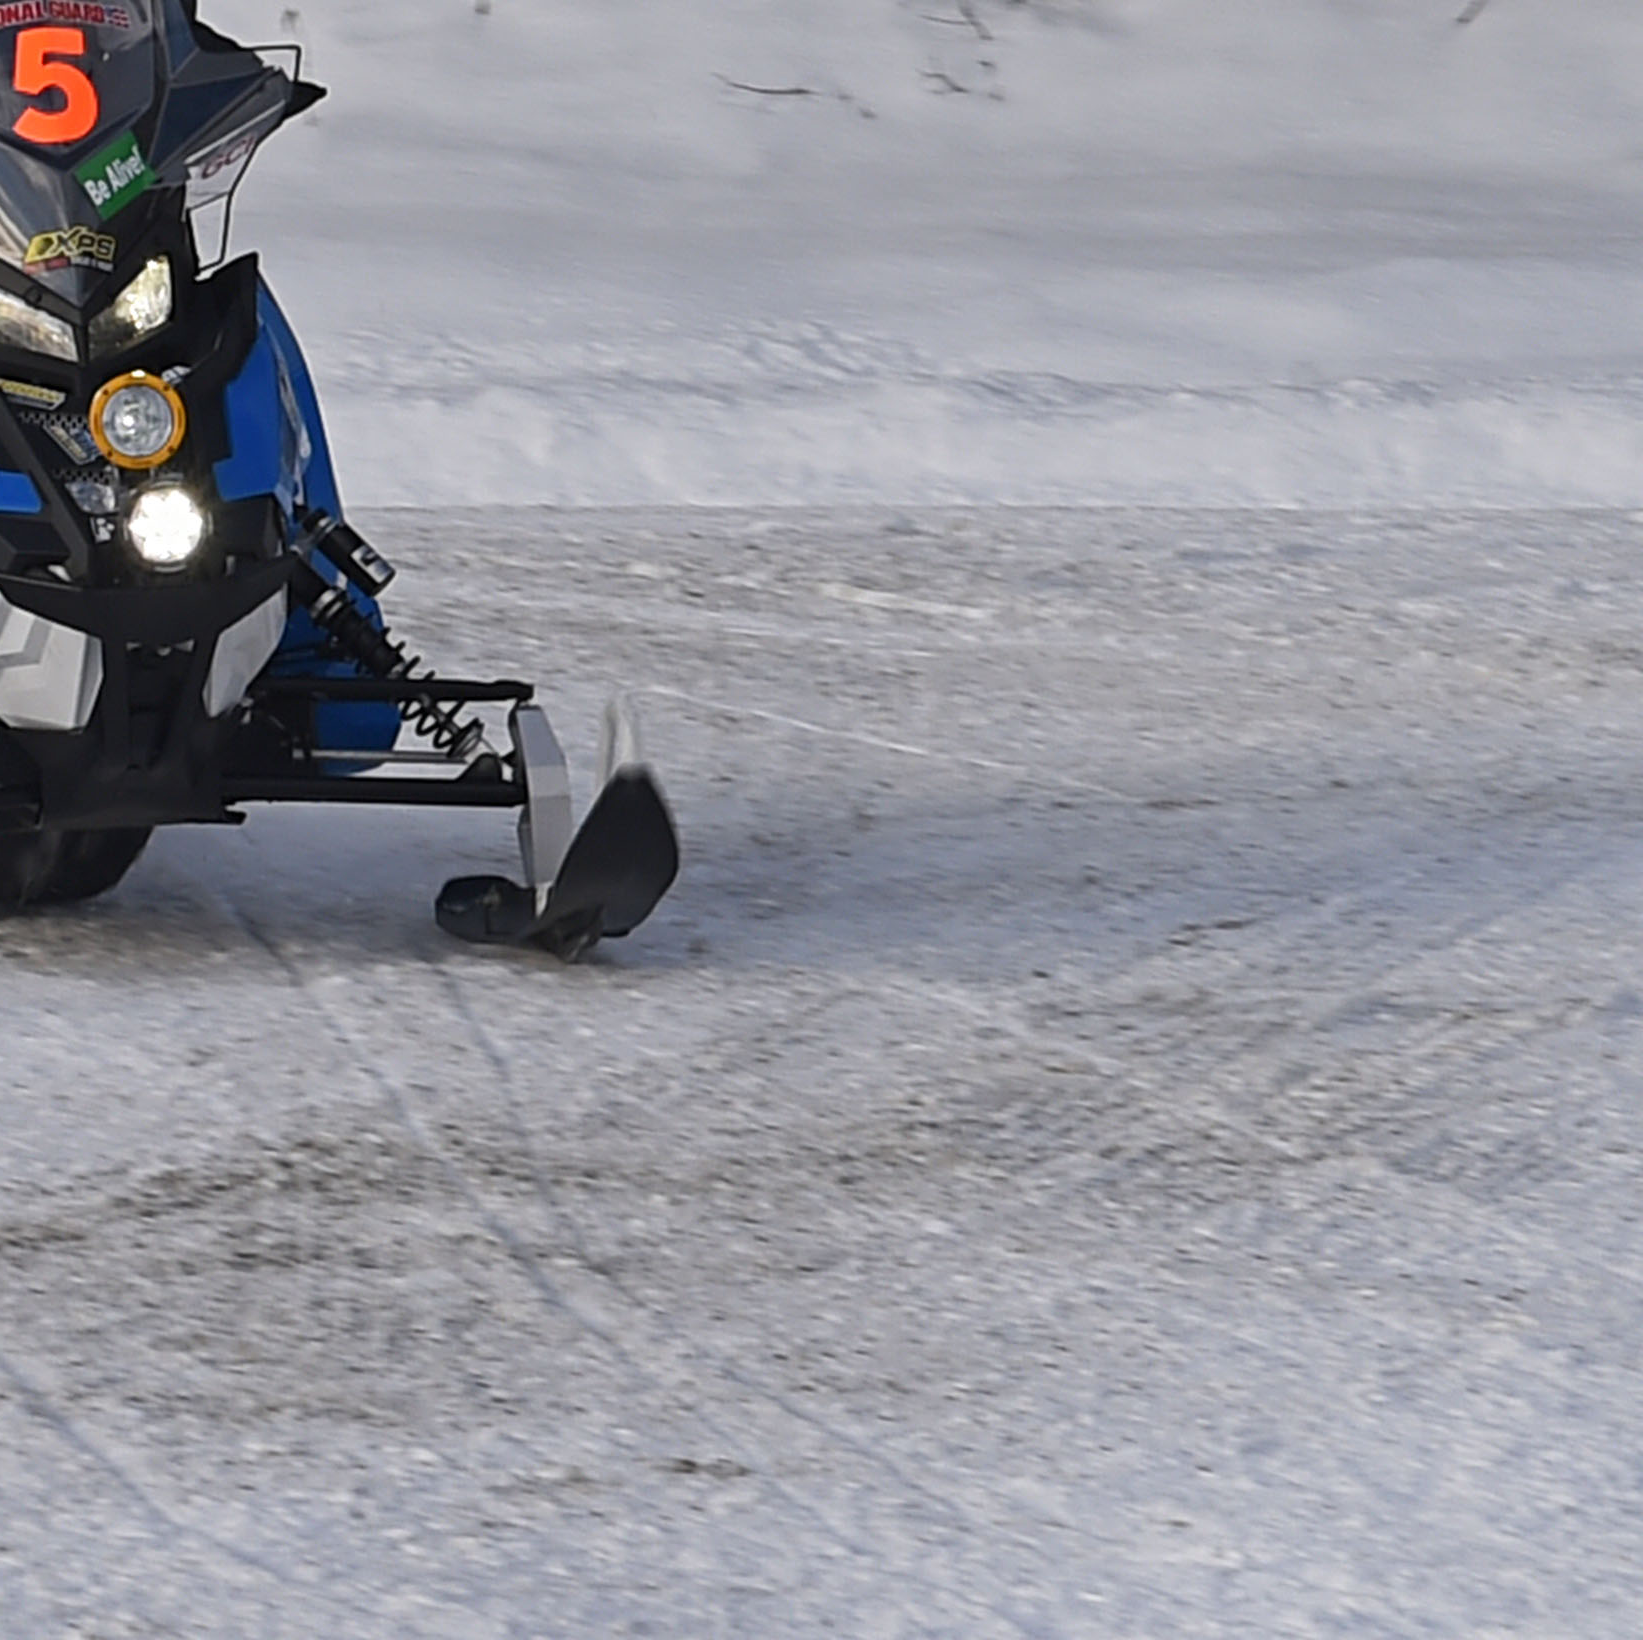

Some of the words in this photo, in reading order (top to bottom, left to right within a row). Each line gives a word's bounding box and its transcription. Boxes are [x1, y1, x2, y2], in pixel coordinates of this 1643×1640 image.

[48, 0, 106, 24] GUARD
[13, 26, 99, 143] 5
[84, 179, 111, 206] Be
[48, 226, 115, 260] XPS
